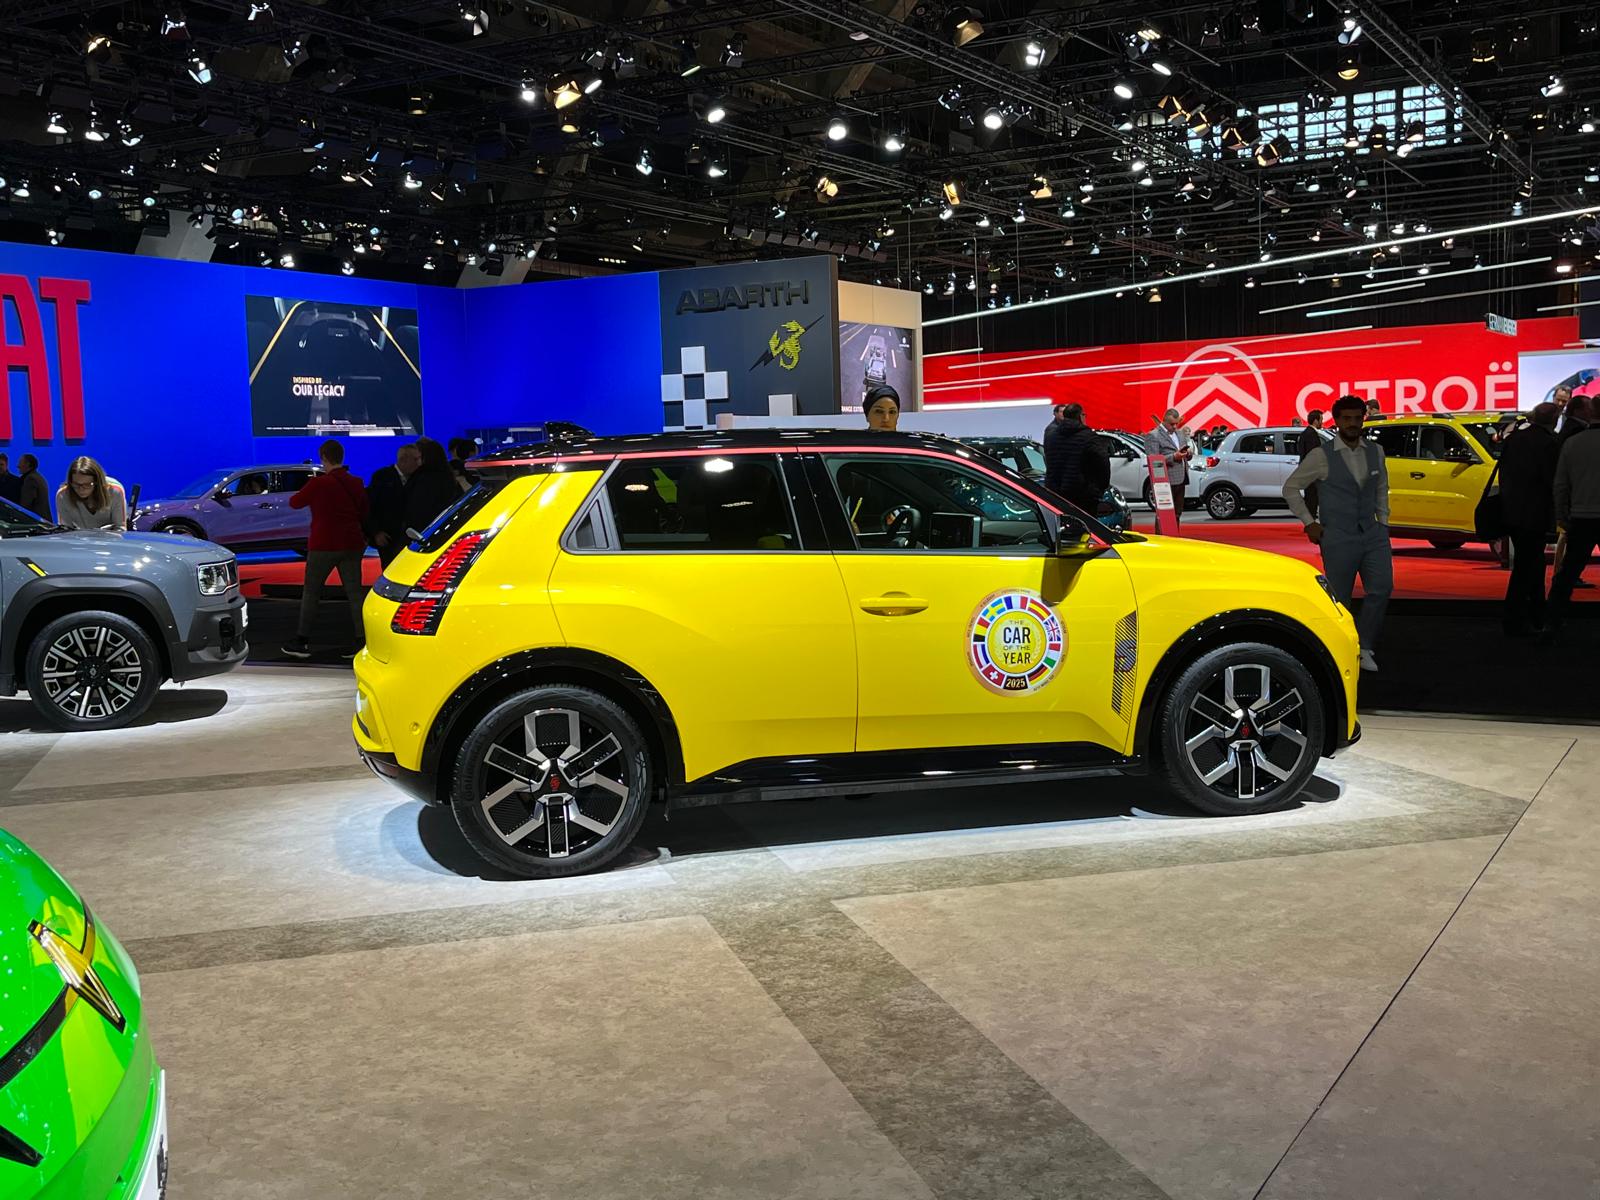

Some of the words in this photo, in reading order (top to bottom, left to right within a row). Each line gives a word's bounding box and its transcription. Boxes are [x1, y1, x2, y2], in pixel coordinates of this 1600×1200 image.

[676, 279, 809, 315] ABARTH
[0, 273, 91, 440] AT
[292, 384, 313, 396] OUR
[313, 385, 345, 397] LEGACY
[1296, 361, 1516, 422] CTROË
[1003, 626, 1031, 644] CAR
[1003, 652, 1031, 664] YEAR
[1005, 678, 1026, 688] 2025
